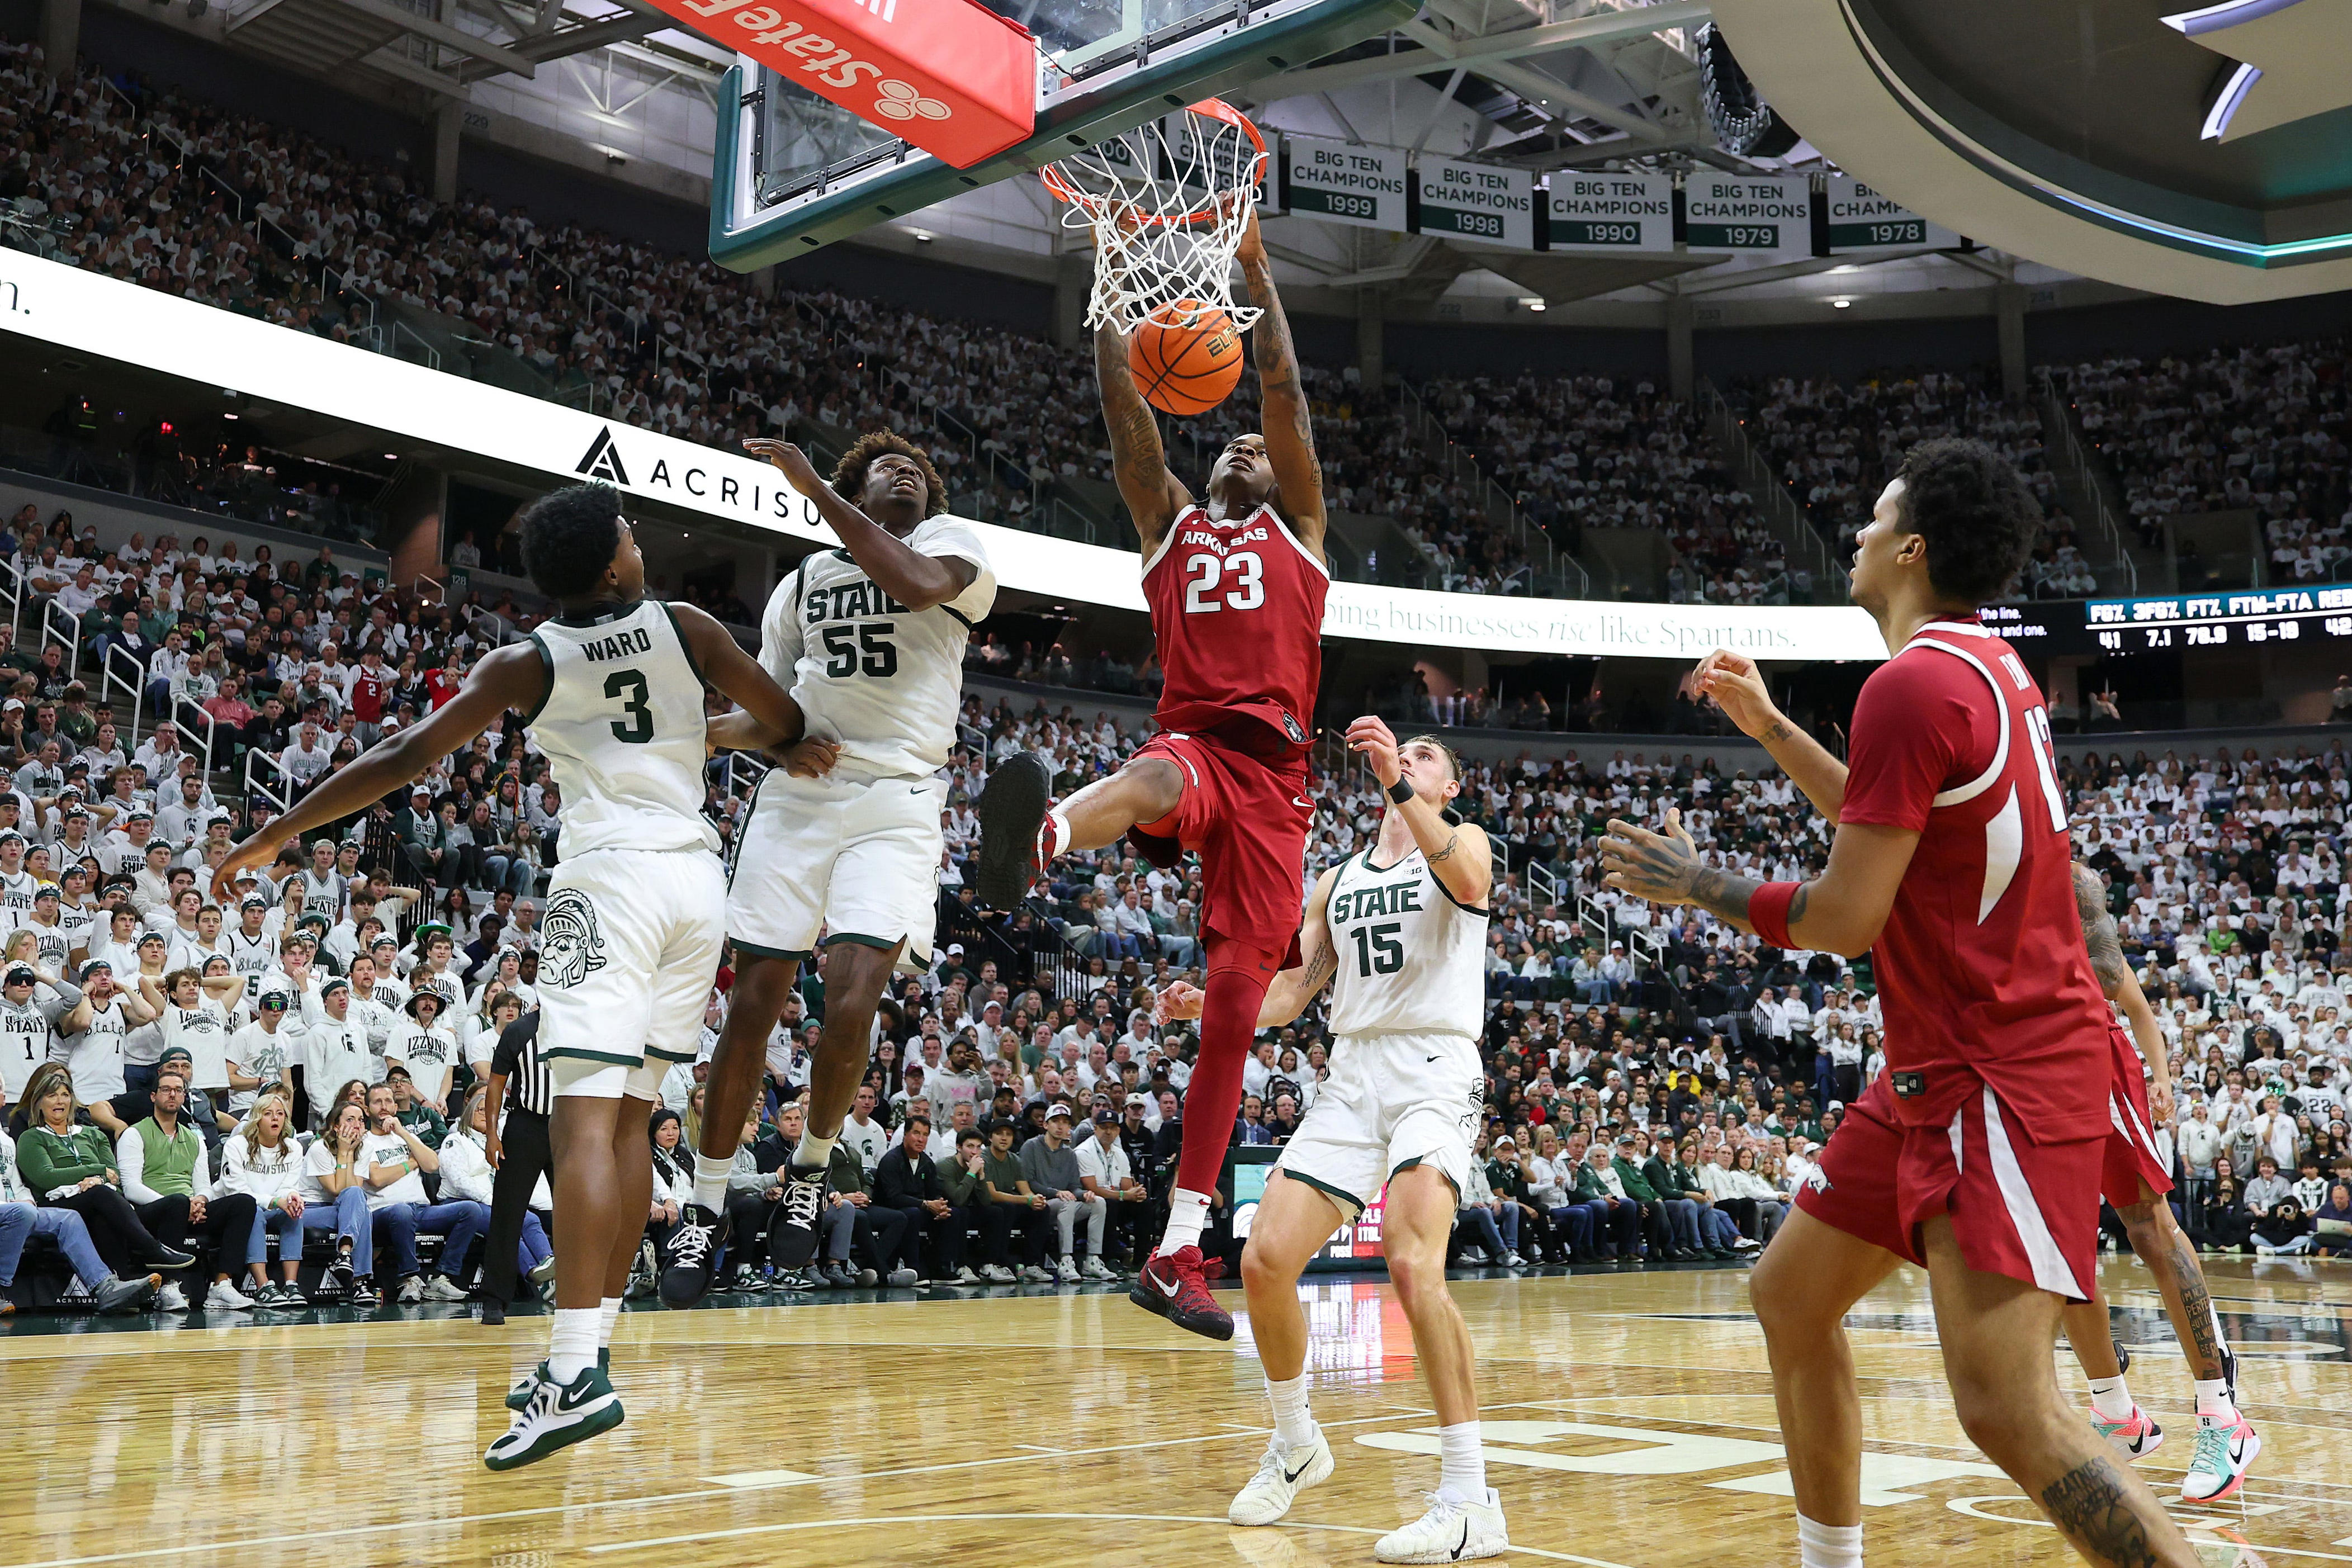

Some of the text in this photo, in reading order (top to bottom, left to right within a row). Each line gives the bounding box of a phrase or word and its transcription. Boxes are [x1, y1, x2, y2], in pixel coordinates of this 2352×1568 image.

[1315, 151, 1382, 172] BIG TEN
[1294, 167, 1403, 193] CHAMPIONS
[1444, 169, 1508, 190] BIG TEN
[1574, 182, 1645, 196] BIG TEN
[1424, 184, 1530, 211] CHAMPIONS
[1712, 184, 1783, 199] BIG TEN
[1326, 195, 1373, 216] 1999
[1553, 199, 1669, 215] CHAMPIONS
[1691, 202, 1806, 218] CHAMPIONS
[1834, 200, 1904, 216] CHAMP
[1454, 212, 1500, 235] 1998
[1586, 224, 1637, 242] 1990
[1870, 223, 1920, 243] 1978
[1725, 227, 1773, 245] 1979
[650, 458, 821, 526] ACRISU
[451, 574, 467, 586] 128
[1185, 551, 1266, 614] 23
[2090, 604, 2127, 623] FG%
[2132, 601, 2180, 620] 3FG%
[2186, 598, 2222, 618] FT%
[1322, 595, 1797, 652] ping businesses rise like Spartans.
[1986, 627, 2000, 637] ne
[2001, 624, 2023, 637] and
[2099, 617, 2352, 649] 41 7.1 78.9 15-19 42
[579, 627, 651, 661] WARD
[822, 622, 898, 678] 55
[368, 683, 377, 697] 2
[603, 669, 654, 743] 3
[1403, 866, 1422, 876] BIG
[1334, 879, 1423, 925] STATE
[12, 911, 19, 930] 1
[37, 935, 67, 953] ZZON
[1350, 922, 1404, 978] 15
[237, 958, 268, 972] State
[248, 975, 260, 996] 5
[371, 987, 401, 1007] ZONE
[23, 1036, 35, 1060] 1
[115, 1039, 120, 1054] 1
[407, 1036, 448, 1056] IZZONE
[375, 1146, 405, 1165] MICHIGAN
[242, 1160, 269, 1176] MICHIGAN
